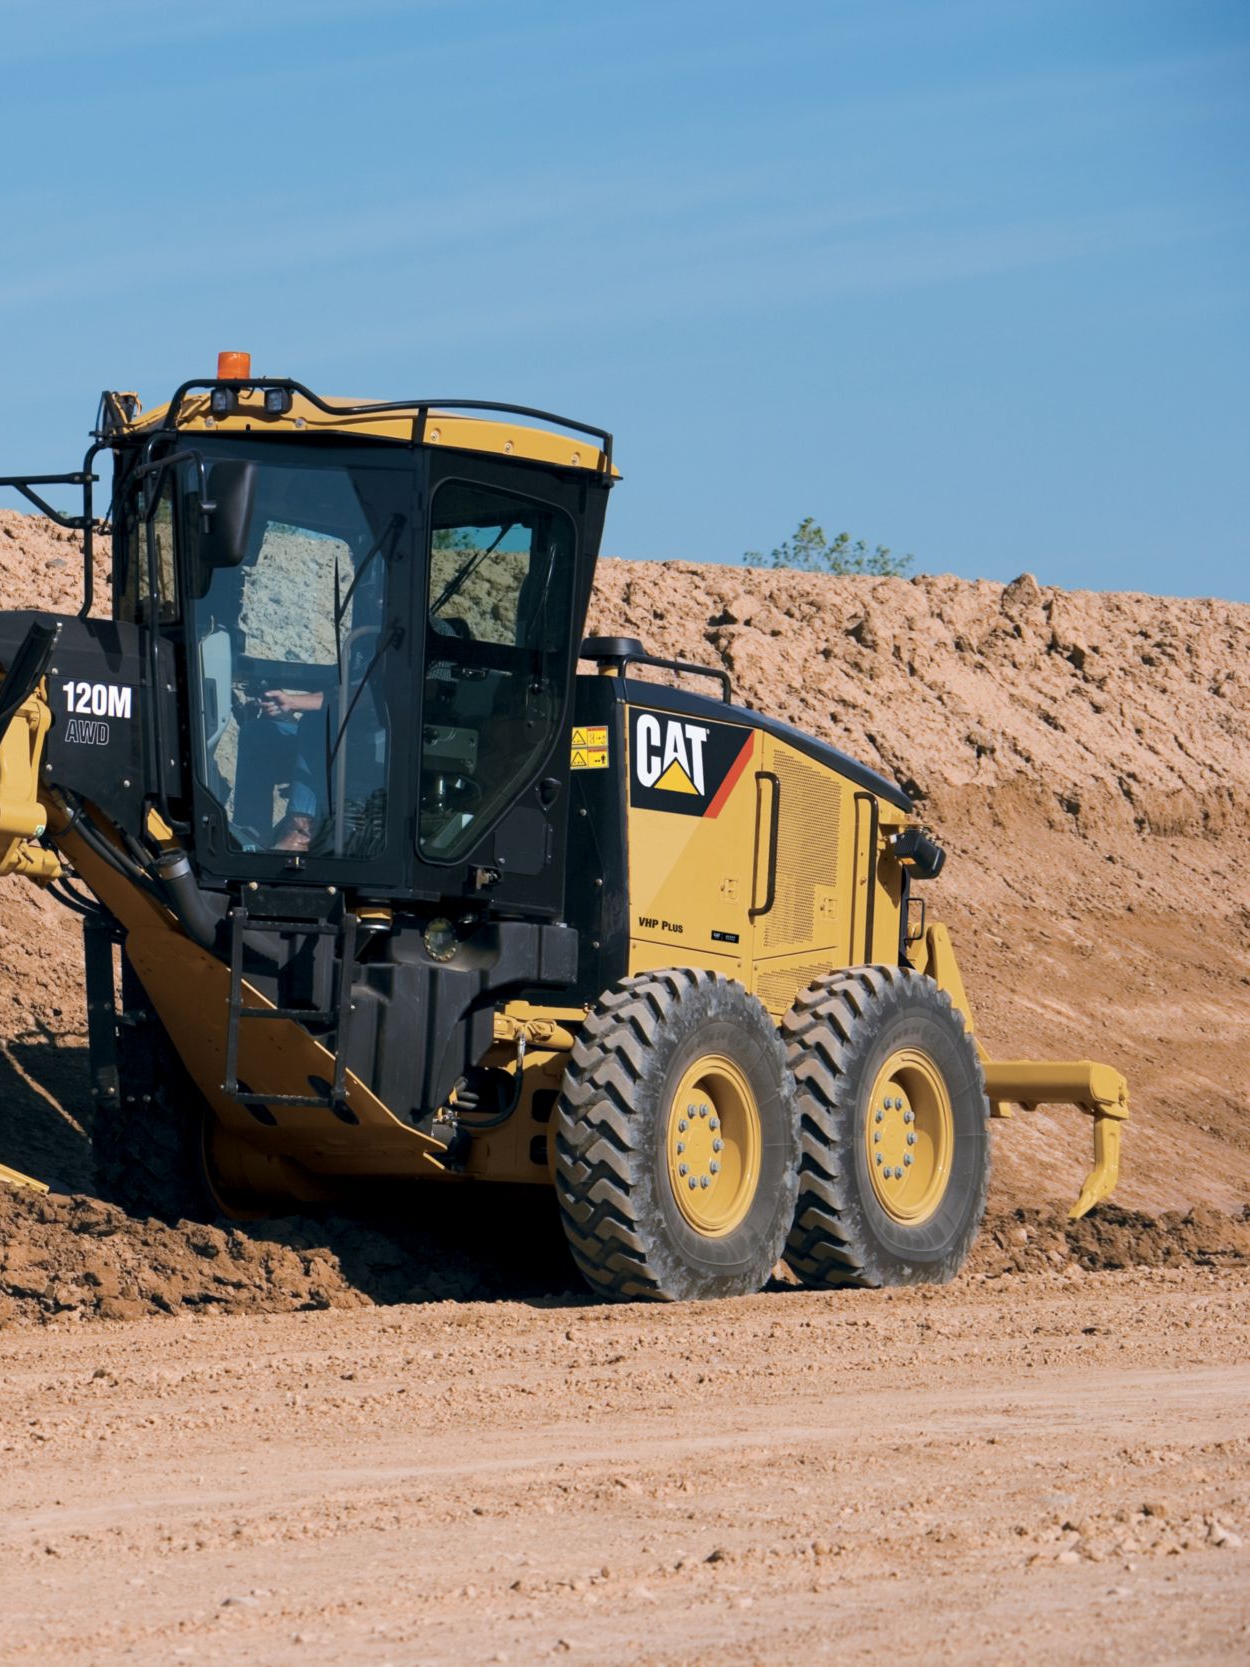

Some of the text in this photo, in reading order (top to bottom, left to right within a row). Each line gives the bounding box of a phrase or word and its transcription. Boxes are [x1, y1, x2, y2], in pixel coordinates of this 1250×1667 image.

[62, 681, 132, 718] 120M
[64, 719, 110, 746] AWD
[636, 713, 707, 796] CAT
[639, 916, 659, 928] VHP
